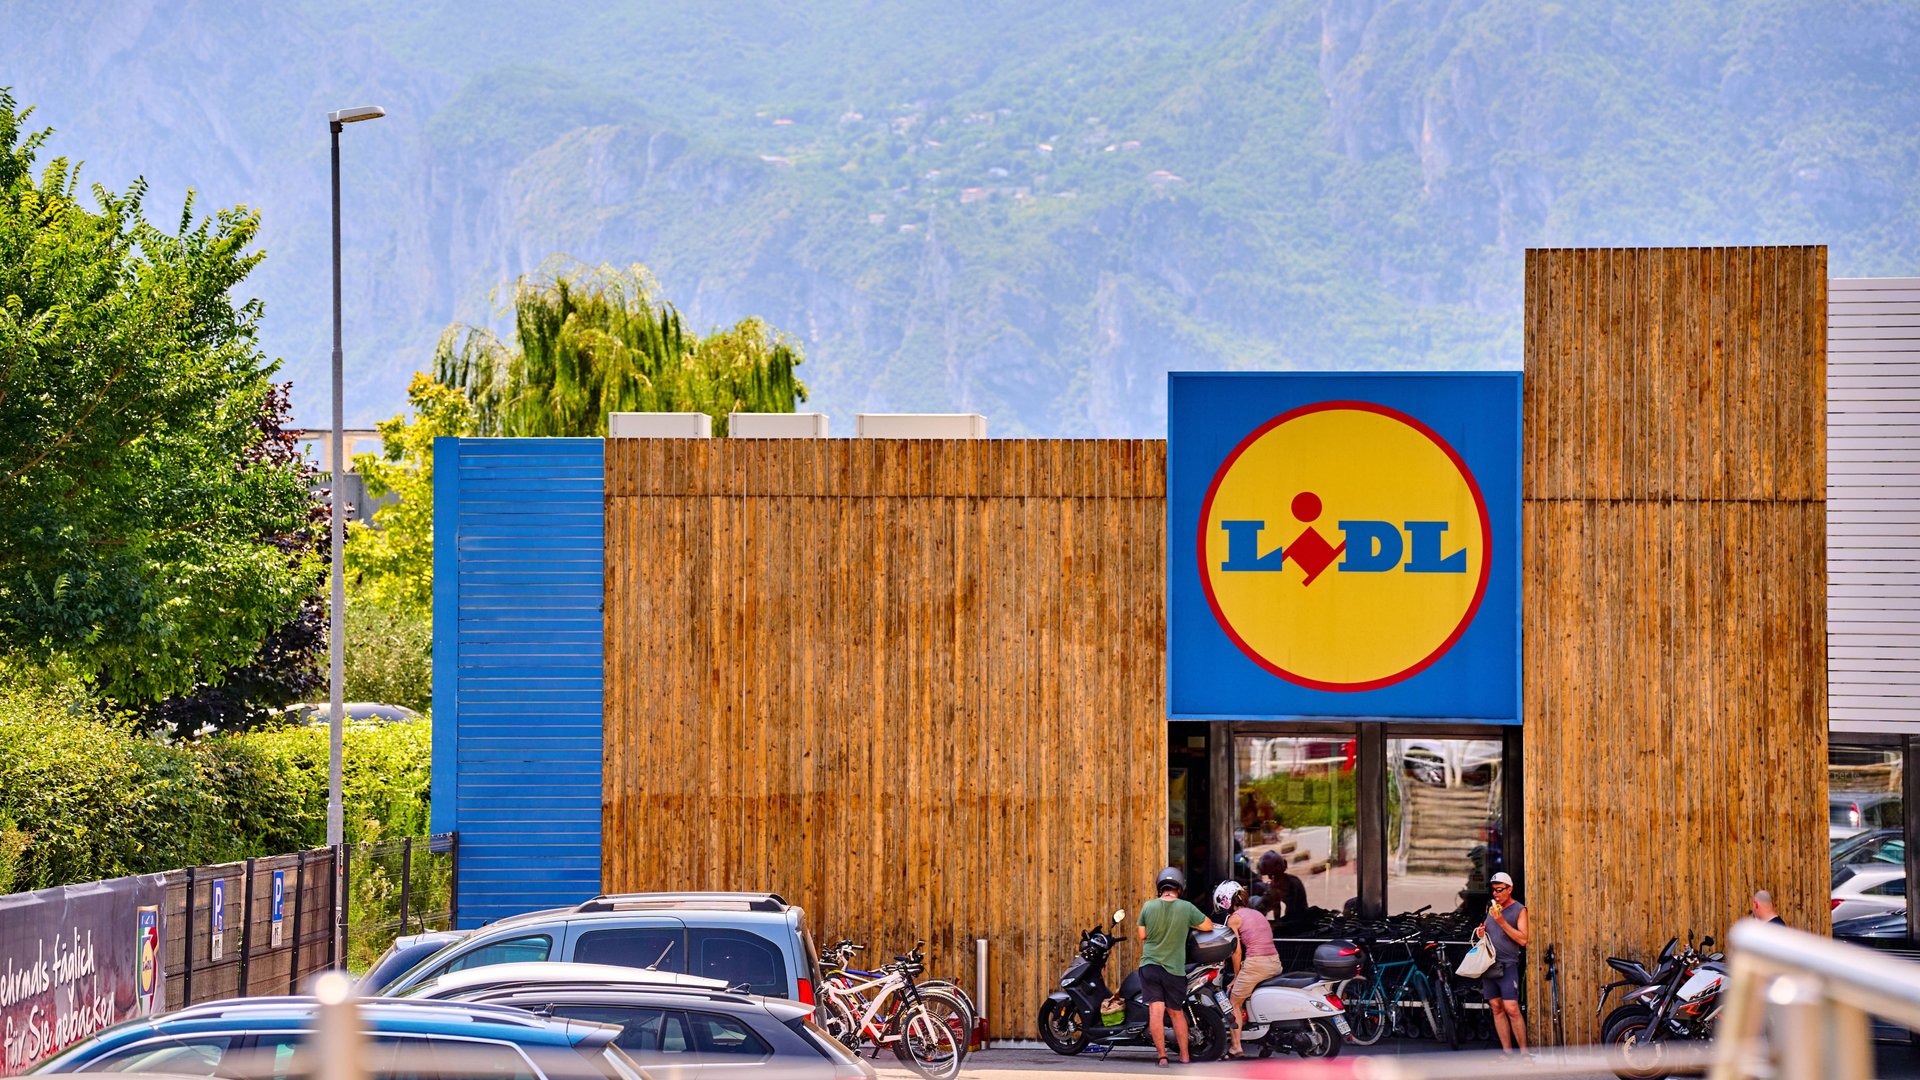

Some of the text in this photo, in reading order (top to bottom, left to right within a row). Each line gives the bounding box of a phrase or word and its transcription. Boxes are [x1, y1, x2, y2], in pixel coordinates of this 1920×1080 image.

[215, 887, 222, 926] P
[275, 878, 282, 915] P
[0, 926, 95, 1007] ehrmals täglich
[4, 1016, 25, 1075] für
[29, 1004, 52, 1060] Sie
